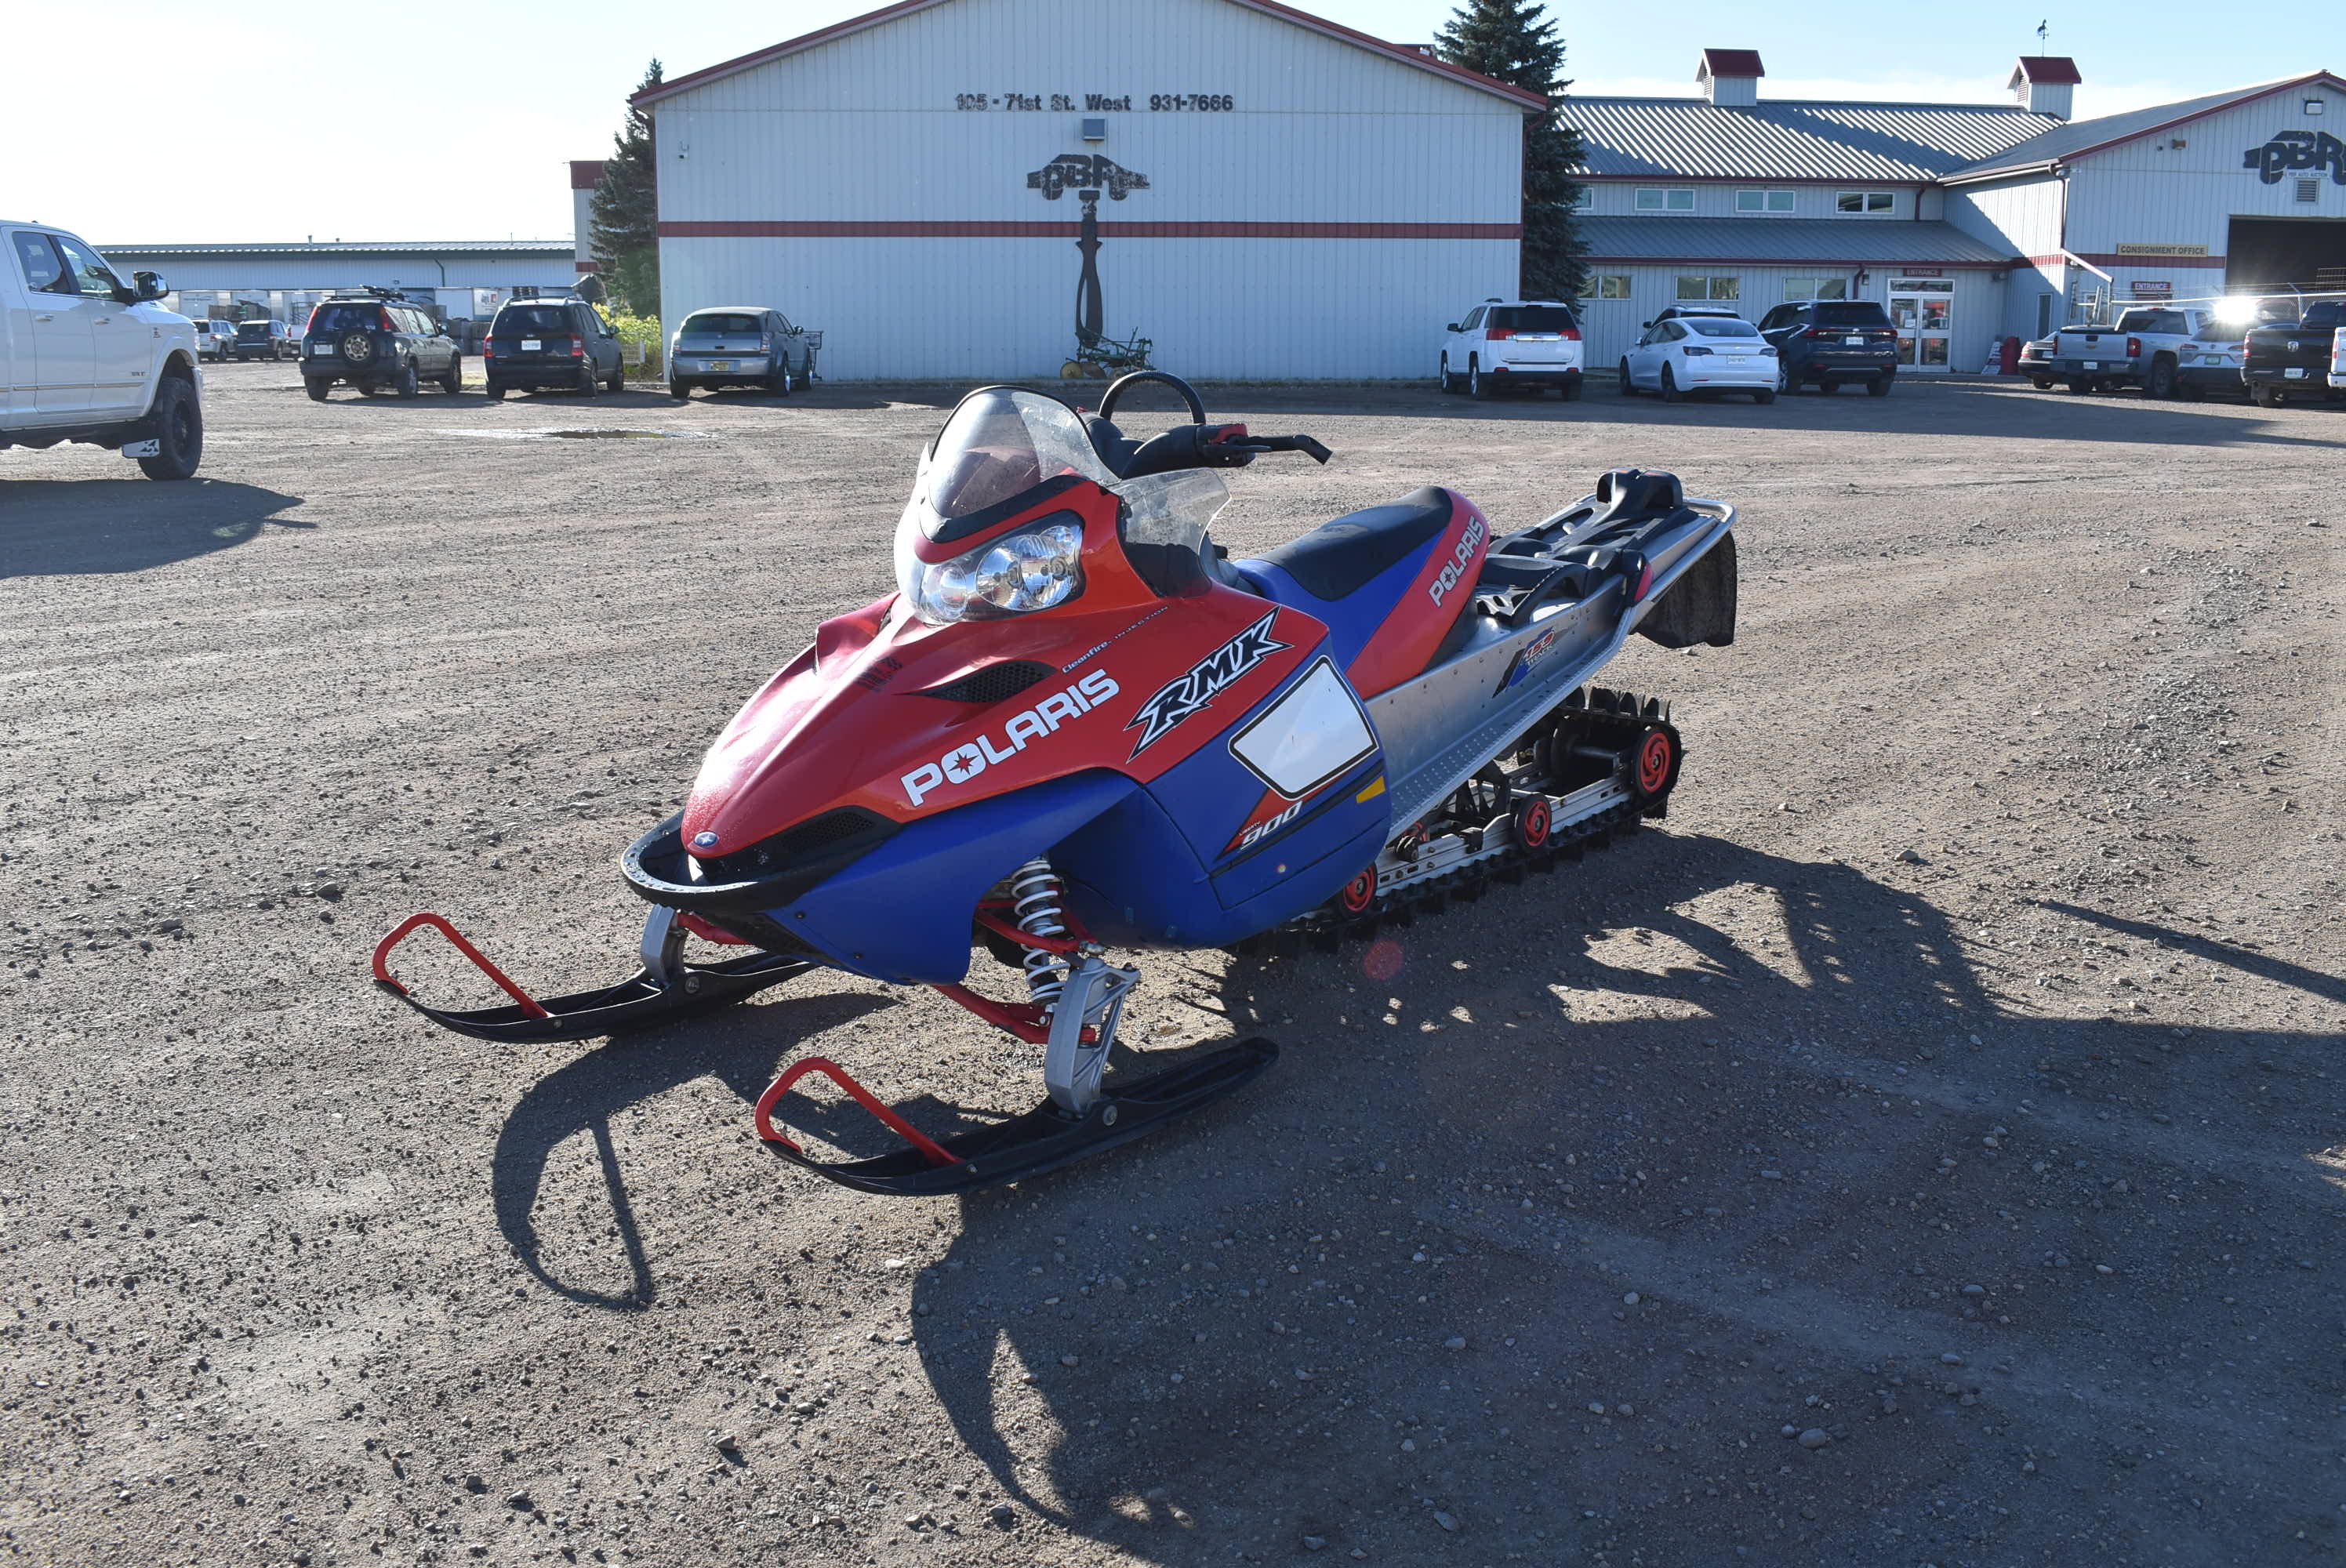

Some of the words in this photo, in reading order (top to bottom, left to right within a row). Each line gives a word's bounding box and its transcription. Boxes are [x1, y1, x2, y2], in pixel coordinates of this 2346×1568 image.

[1004, 93, 1043, 111] 71st
[1050, 93, 1077, 111] St.
[1084, 93, 1131, 111] West
[1149, 93, 1234, 111] 931-7666
[2120, 245, 2177, 255] CONSIGNMENT
[2134, 281, 2168, 290] ENTRANCE
[1429, 515, 1484, 608] POLARIS
[1062, 641, 1109, 673] Cleanfire
[1123, 604, 1295, 765] RMK
[900, 668, 1120, 808] POLARIS
[1240, 799, 1303, 851] 900
